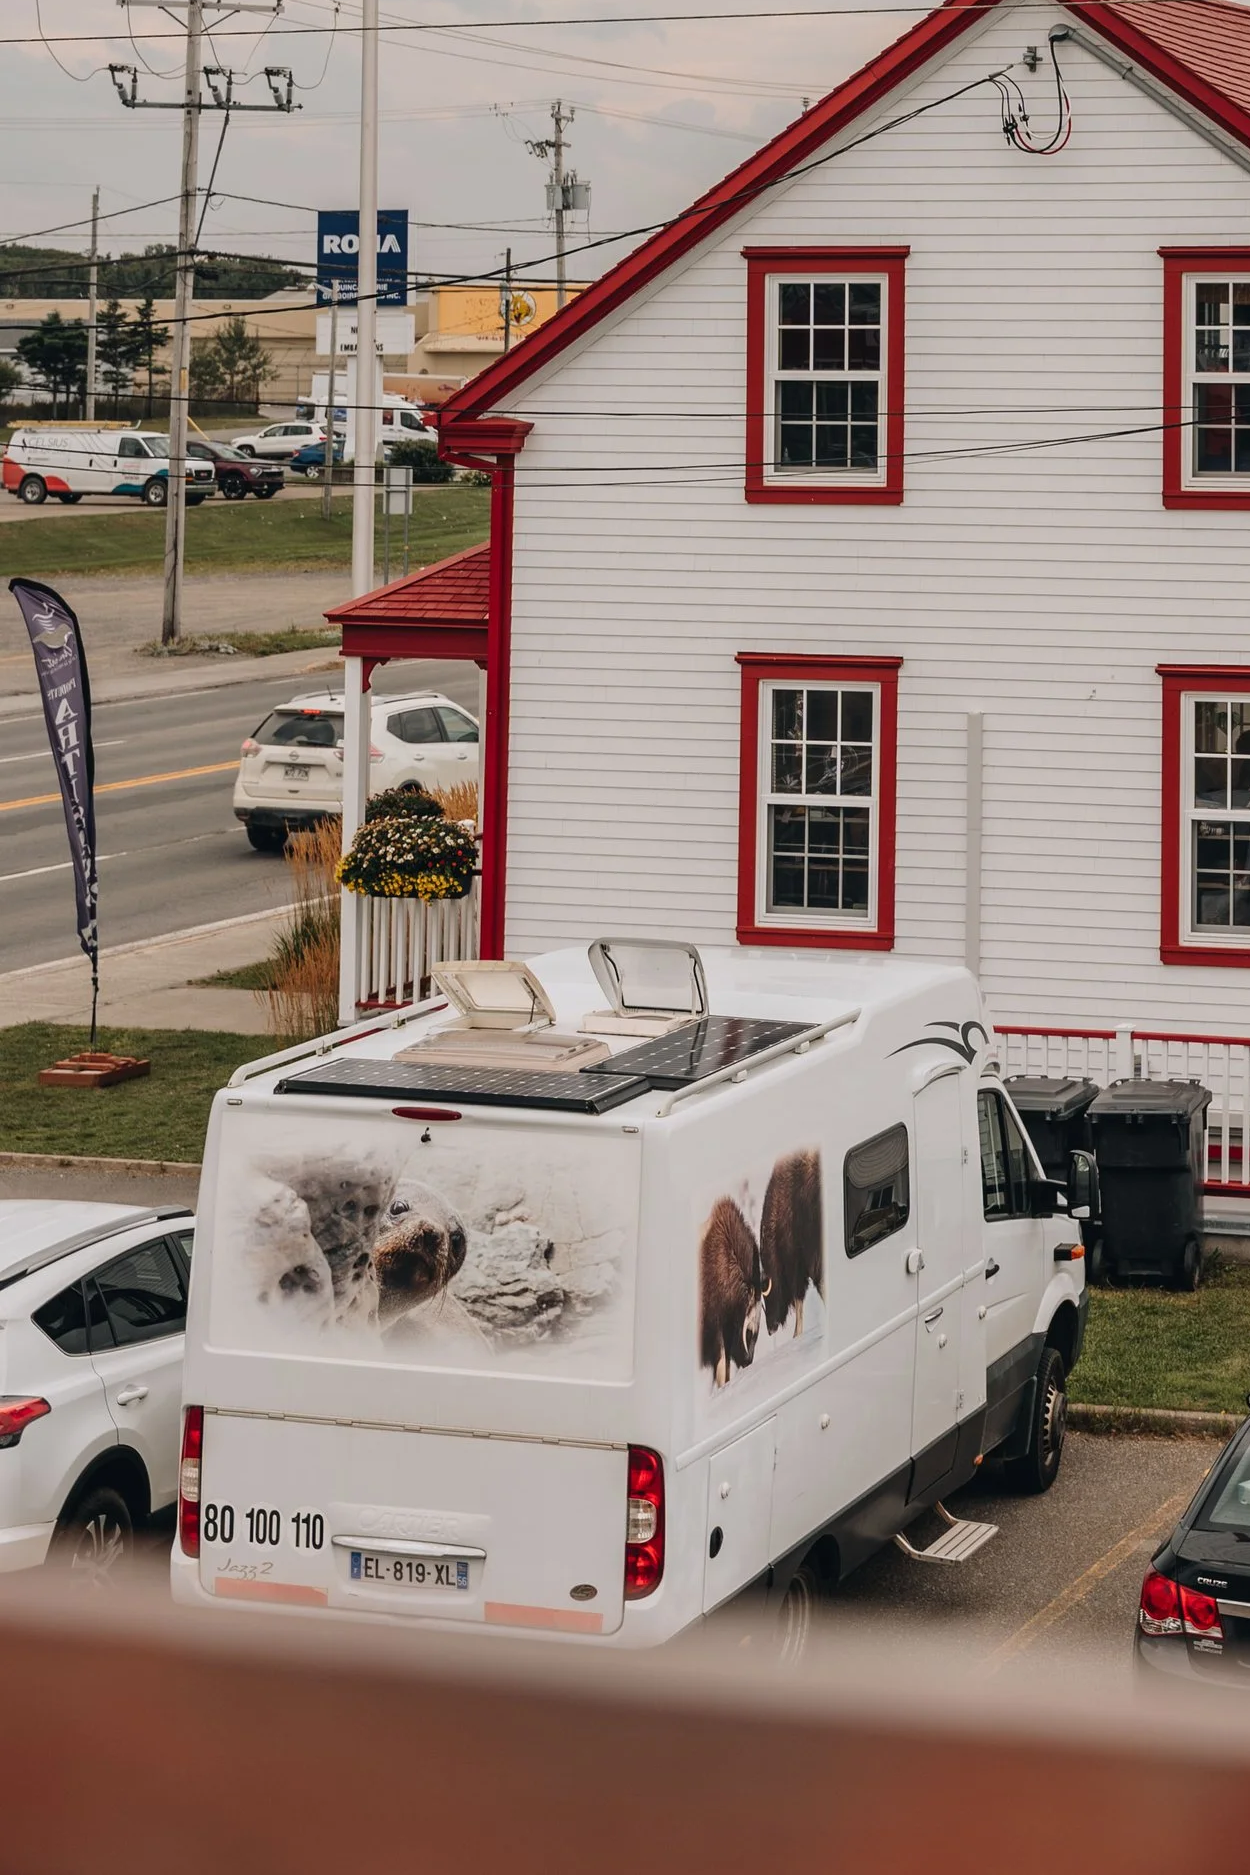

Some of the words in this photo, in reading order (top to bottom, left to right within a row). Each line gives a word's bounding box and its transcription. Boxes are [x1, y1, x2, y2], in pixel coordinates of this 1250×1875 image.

[323, 234, 401, 254] ROA
[340, 343, 384, 352] EMBANS
[28, 436, 69, 449] CELSIUS
[204, 1503, 235, 1543] 80
[245, 1507, 281, 1546] 100
[291, 1512, 324, 1550] 110
[217, 1558, 258, 1580] Jazz
[261, 1562, 274, 1575] 2
[457, 1576, 467, 1587] 56
[1197, 1576, 1228, 1589] CRUZE
